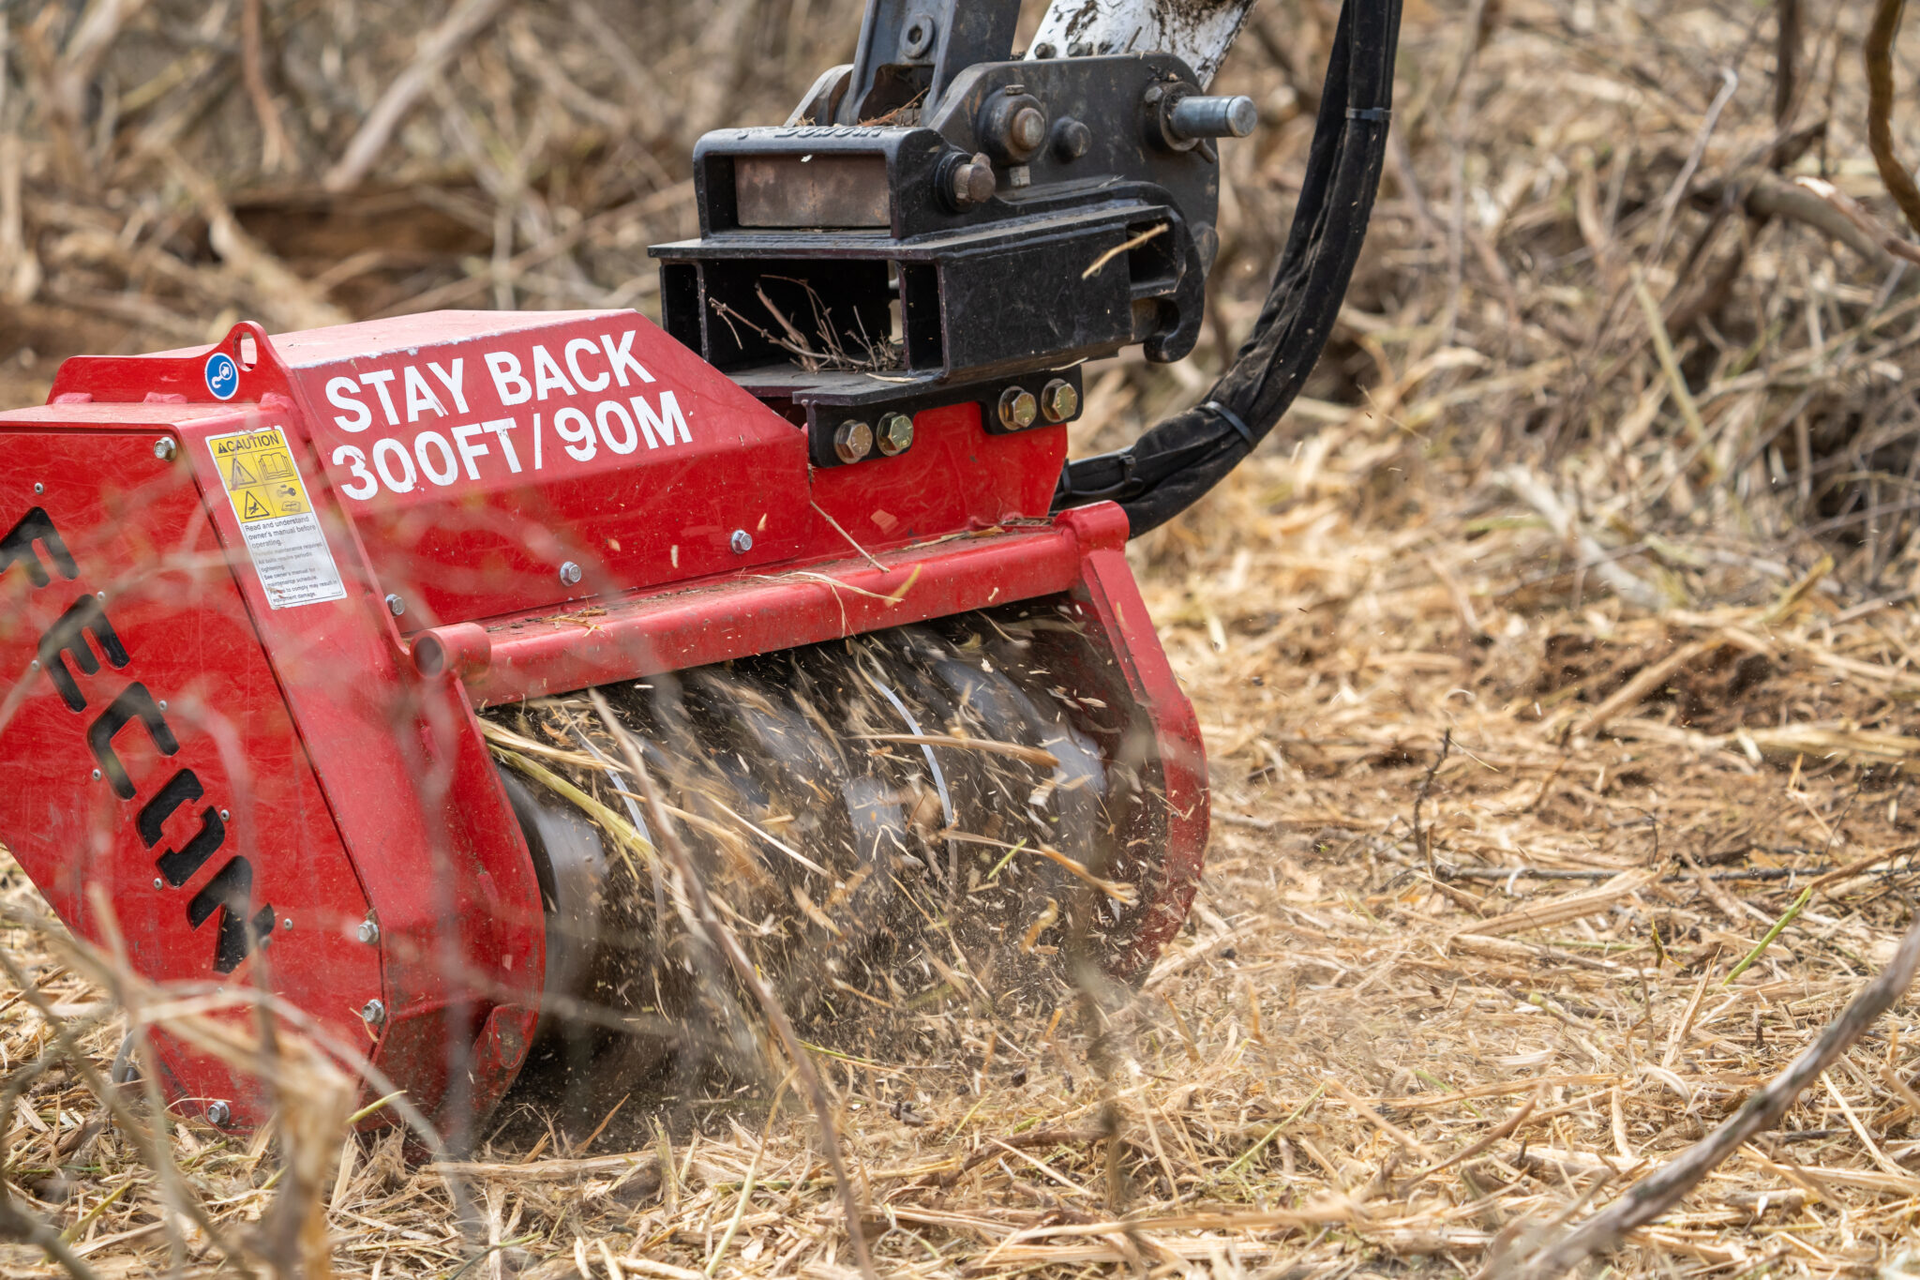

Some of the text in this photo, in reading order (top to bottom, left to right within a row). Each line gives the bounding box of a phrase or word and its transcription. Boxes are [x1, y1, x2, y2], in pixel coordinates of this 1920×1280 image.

[325, 330, 656, 432] STAY BACK
[226, 433, 280, 452] CAUTION
[244, 523, 261, 531] Read
[274, 515, 310, 526] understand
[272, 527, 296, 536] manual
[0, 506, 275, 974] FECON
